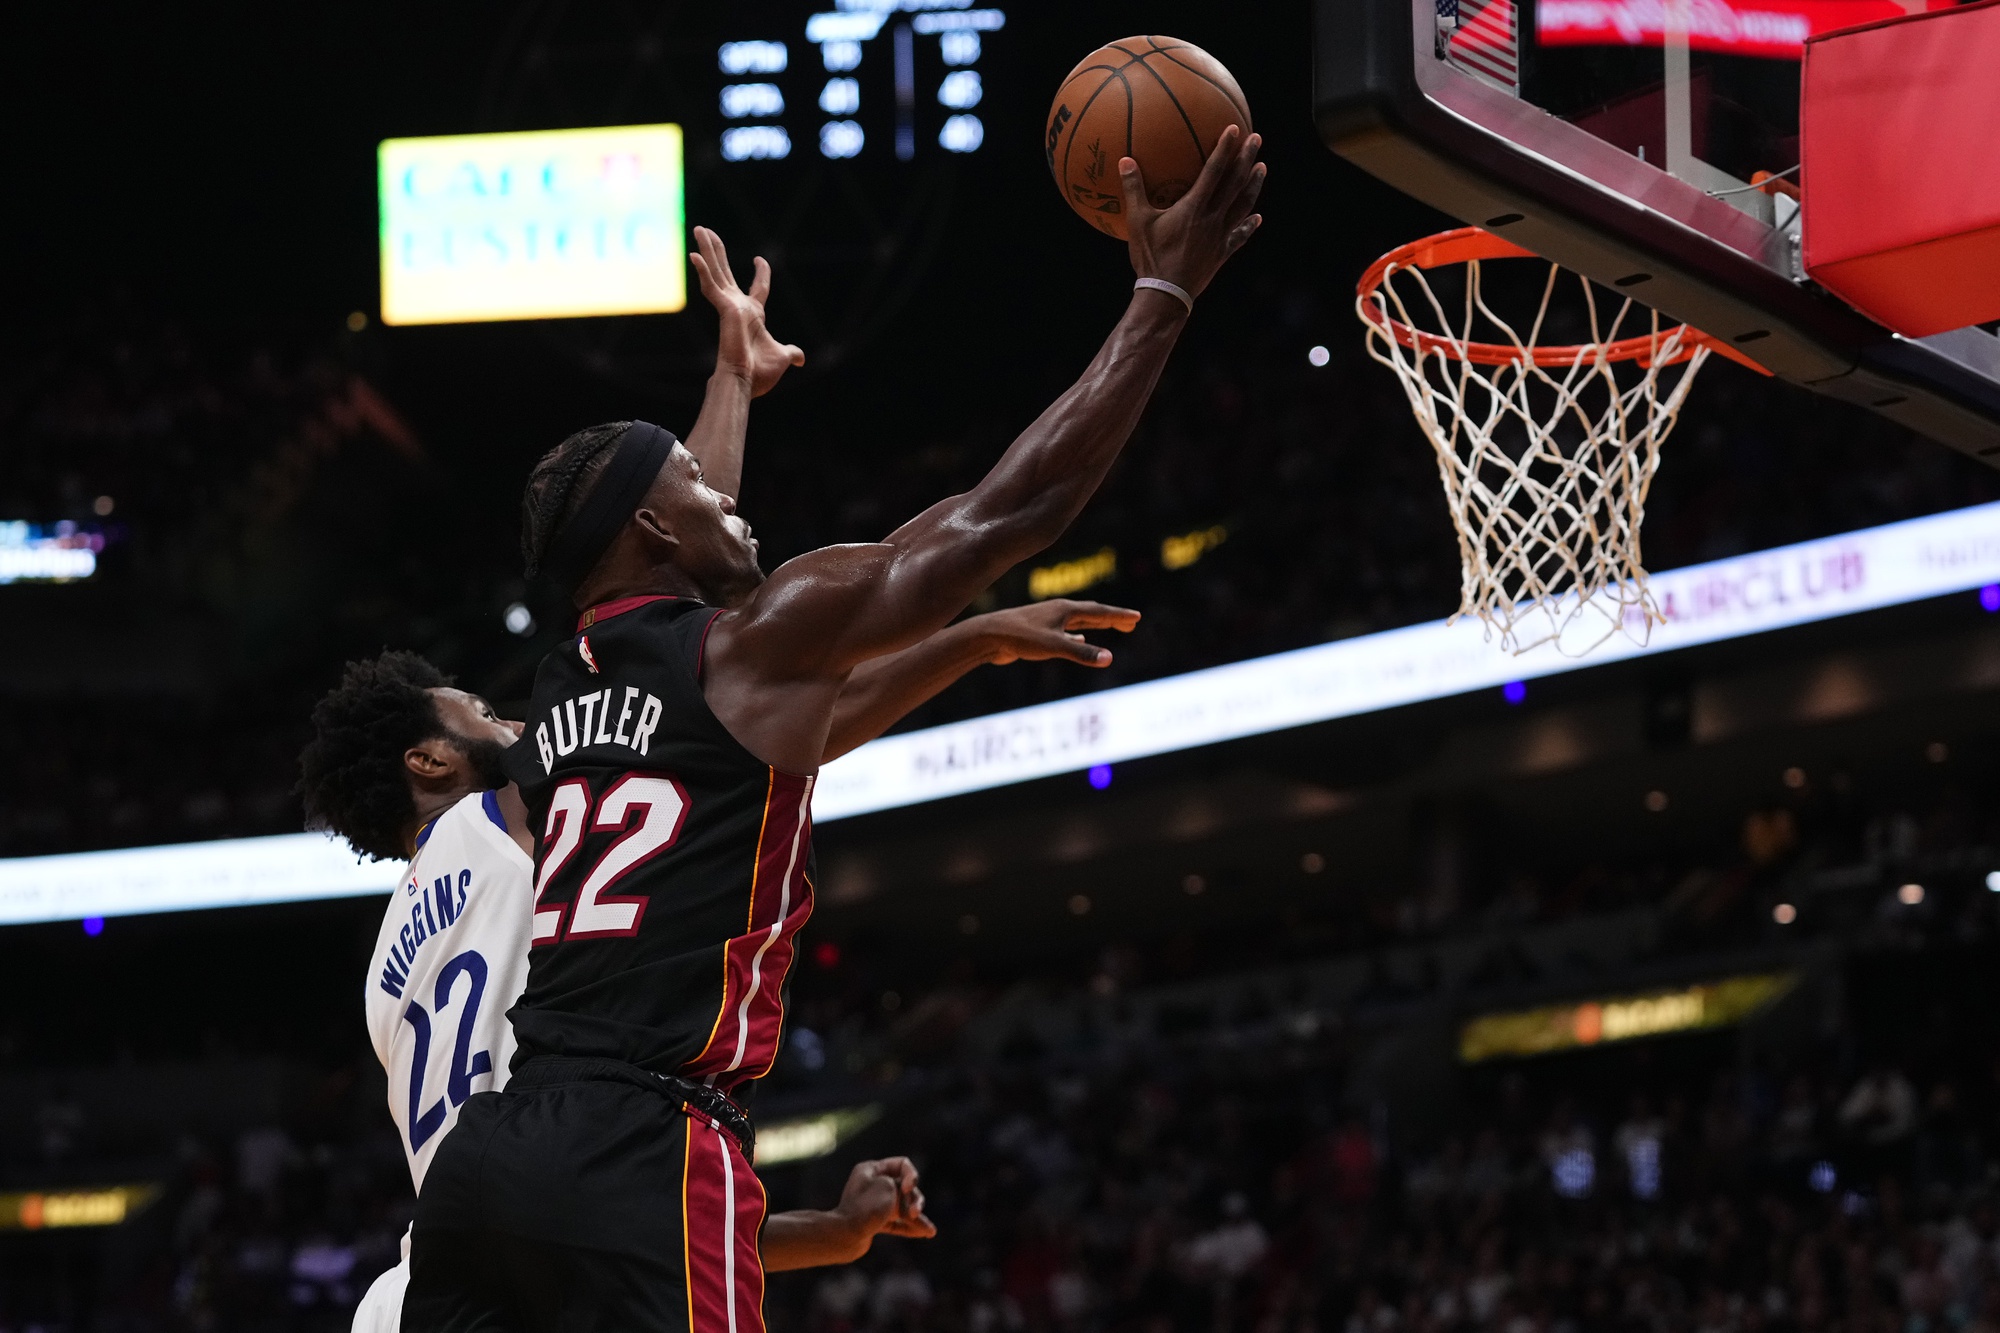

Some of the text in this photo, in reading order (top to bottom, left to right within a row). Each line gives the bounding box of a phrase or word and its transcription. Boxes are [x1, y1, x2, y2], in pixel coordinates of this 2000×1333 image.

[536, 686, 663, 776] BUTLER
[380, 868, 472, 1000] WIGGINS
[531, 770, 693, 947] 22
[404, 949, 492, 1156] 22
